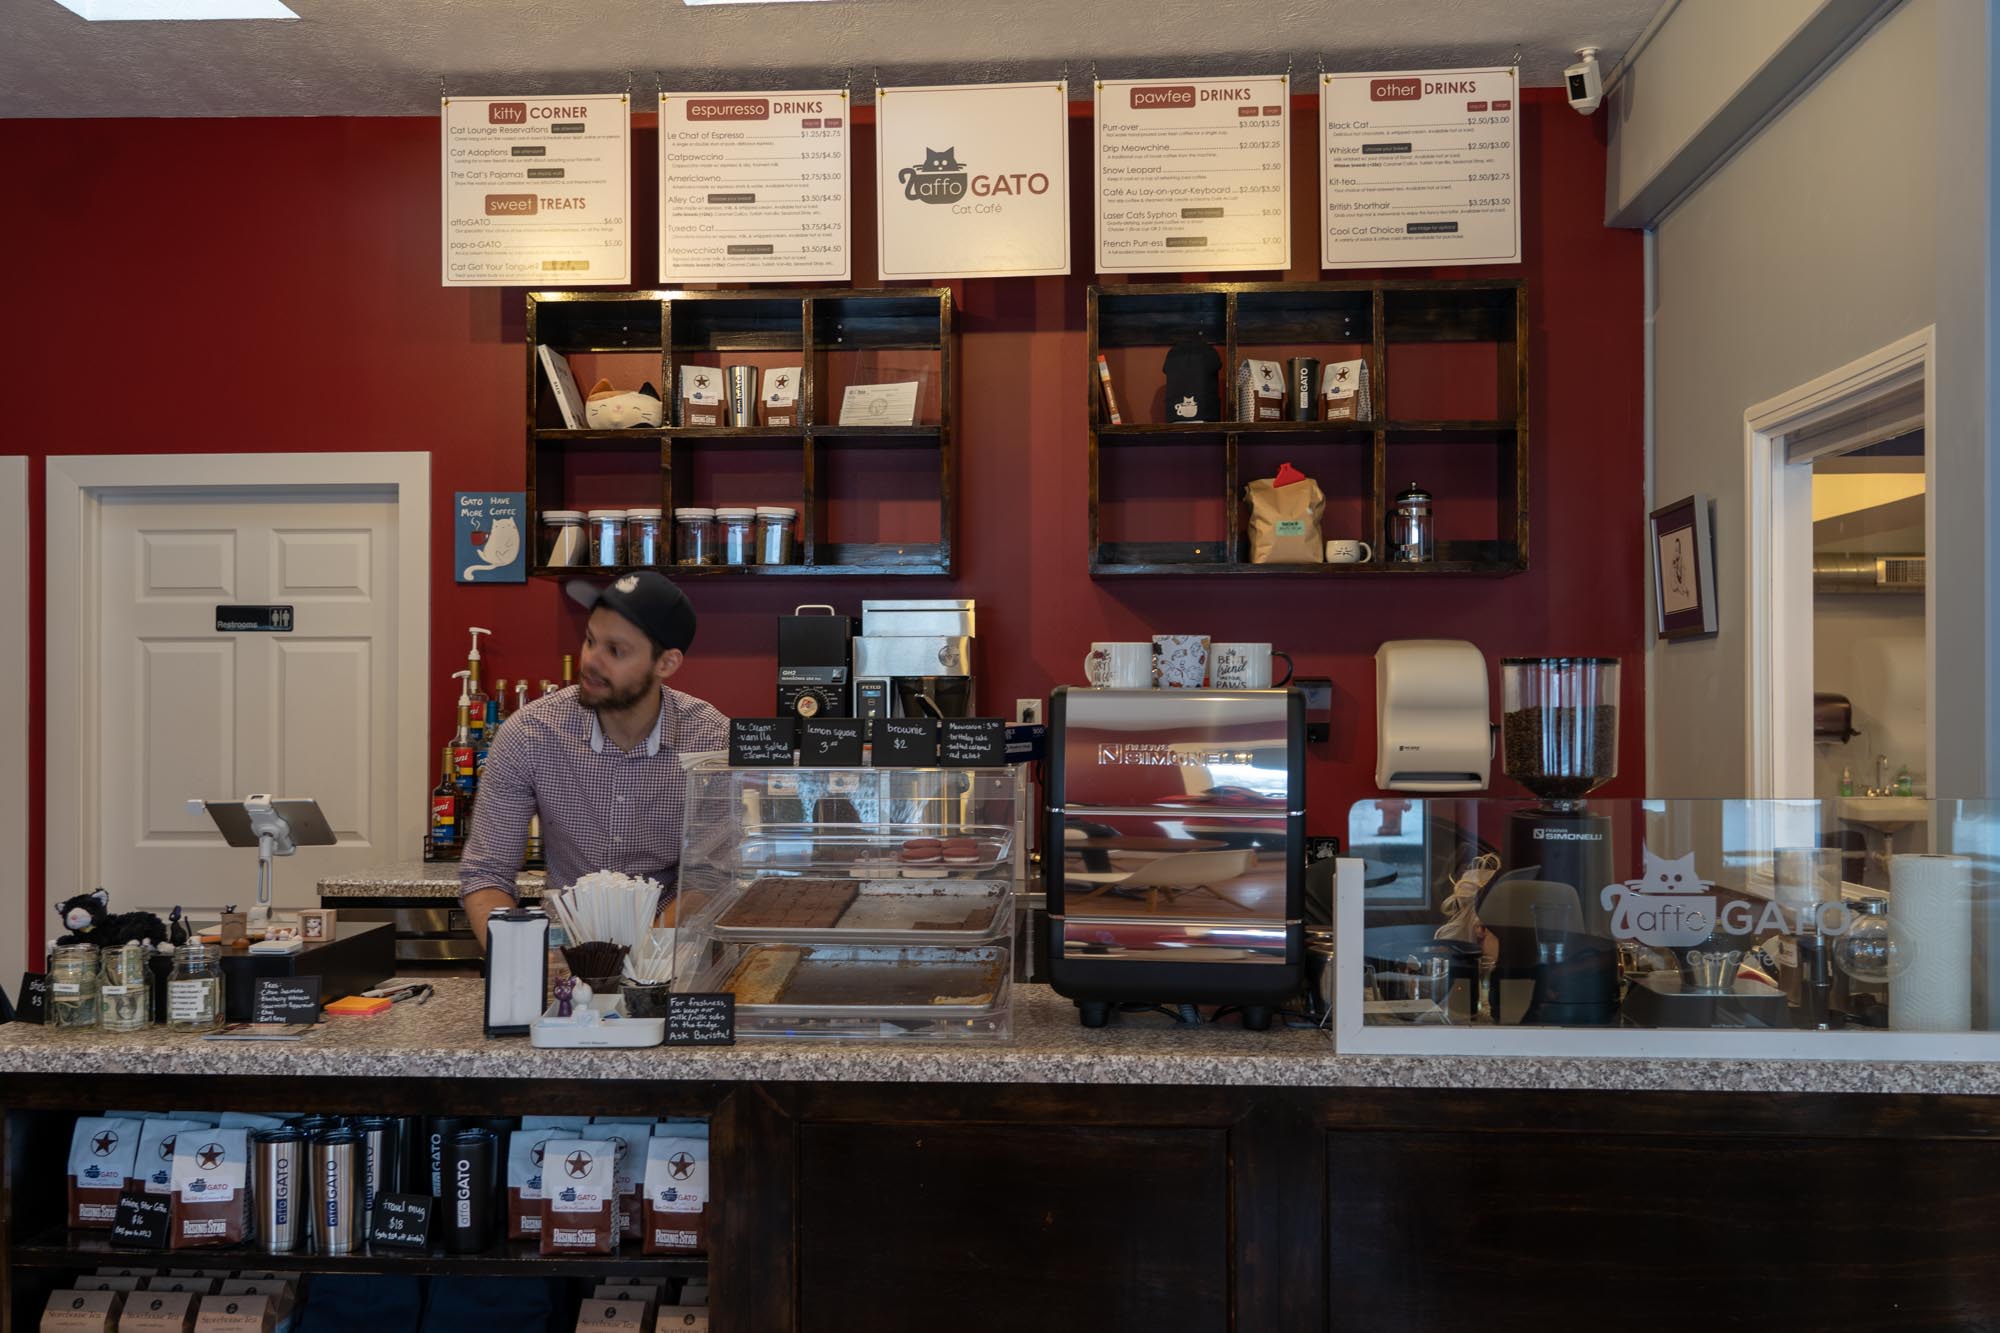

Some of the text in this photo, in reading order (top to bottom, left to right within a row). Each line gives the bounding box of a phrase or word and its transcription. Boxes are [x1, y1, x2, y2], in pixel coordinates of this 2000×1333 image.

[1376, 81, 1477, 98] other DRINKS
[1135, 88, 1251, 106] pawfee DRINKS
[494, 107, 588, 122] kitty CORNER
[691, 101, 823, 118] espurresso DRINKS
[450, 126, 466, 135] Cat
[467, 126, 498, 136] Lounge
[500, 125, 549, 134] Reservations
[1103, 123, 1139, 131] Purr-over
[1328, 122, 1351, 130] Black
[1353, 121, 1369, 129] Cat
[667, 132, 677, 140] Le
[678, 132, 700, 140] Chat
[711, 131, 745, 141] Espresso
[450, 149, 467, 157] Cat
[469, 148, 508, 158] Adoptions
[1102, 144, 1119, 153] Drip
[1121, 143, 1170, 152] Meowchine
[1329, 146, 1360, 155] Whisker
[667, 153, 724, 162] Catpawccino
[450, 171, 464, 179] The
[466, 171, 488, 179] Cat's
[489, 170, 524, 180] Pajamas
[1102, 166, 1125, 174] Snow
[1127, 165, 1162, 175] Leopard
[667, 174, 721, 183] Americlawno
[1329, 178, 1356, 186] Kit-tea
[919, 173, 1050, 197] affo GATO
[1103, 187, 1124, 197] Café
[1126, 188, 1137, 196] Au
[1139, 186, 1231, 197] Lay-on-your-Keyboard
[491, 198, 586, 211] sweet TREATS
[667, 195, 688, 205] Alley
[689, 195, 705, 204] Cat
[952, 203, 1003, 215] Cat Café
[1329, 202, 1352, 211] British
[1354, 201, 1390, 210] Shorthair
[1103, 211, 1124, 219] Laser
[1126, 211, 1145, 219] Cats
[1147, 210, 1178, 221] Syphon
[668, 224, 697, 232] Tuxedo
[699, 224, 715, 232] Cat
[1330, 226, 1404, 236] Cool Cat Choices
[1103, 239, 1132, 247] French
[1133, 239, 1164, 247] Purr-ess
[450, 263, 467, 271] Cat
[469, 263, 484, 271] Got
[484, 262, 503, 271] Your
[461, 495, 510, 506] GATO HAVE
[461, 507, 517, 517] MORE COFFEE
[1218, 656, 1245, 664] BET
[807, 725, 832, 736] lemon
[887, 723, 927, 735] brownie
[894, 739, 908, 749] $2
[1636, 901, 1853, 936] affo GATO
[670, 997, 685, 1007] For
[670, 1029, 730, 1040] Ask Barista!
[408, 1205, 426, 1222] mug
[389, 1216, 404, 1230] $18
